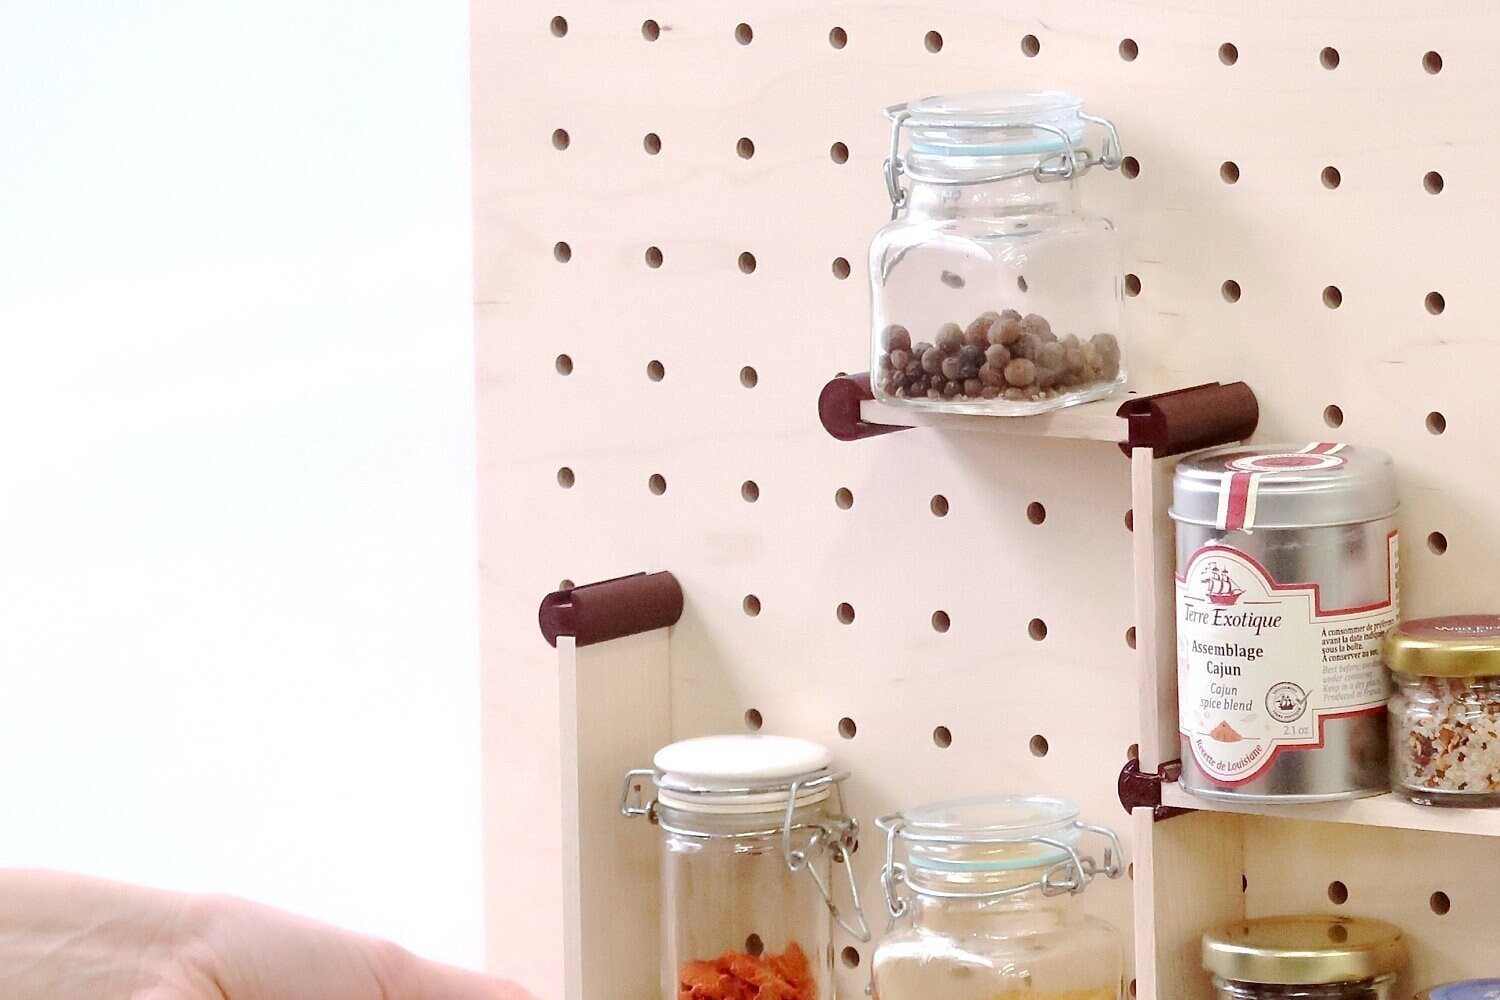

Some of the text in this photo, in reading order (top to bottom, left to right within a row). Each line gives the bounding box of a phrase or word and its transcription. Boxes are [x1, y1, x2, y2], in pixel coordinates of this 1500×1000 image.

[1184, 603, 1282, 636] Terre Exotique
[1328, 626, 1365, 637] consommer
[1321, 637, 1341, 645] avant
[1342, 635, 1348, 643] la
[1349, 634, 1363, 642] date
[1191, 639, 1264, 661] Assemblage
[1321, 646, 1338, 654] sous
[1339, 644, 1345, 652] la
[1328, 652, 1361, 662] conserver
[1206, 660, 1241, 679] Cajun
[1210, 682, 1238, 698] Cajun
[1200, 697, 1253, 711] spice blend
[1298, 727, 1309, 735] oz
[1196, 739, 1263, 771] Recette de Louisiane
